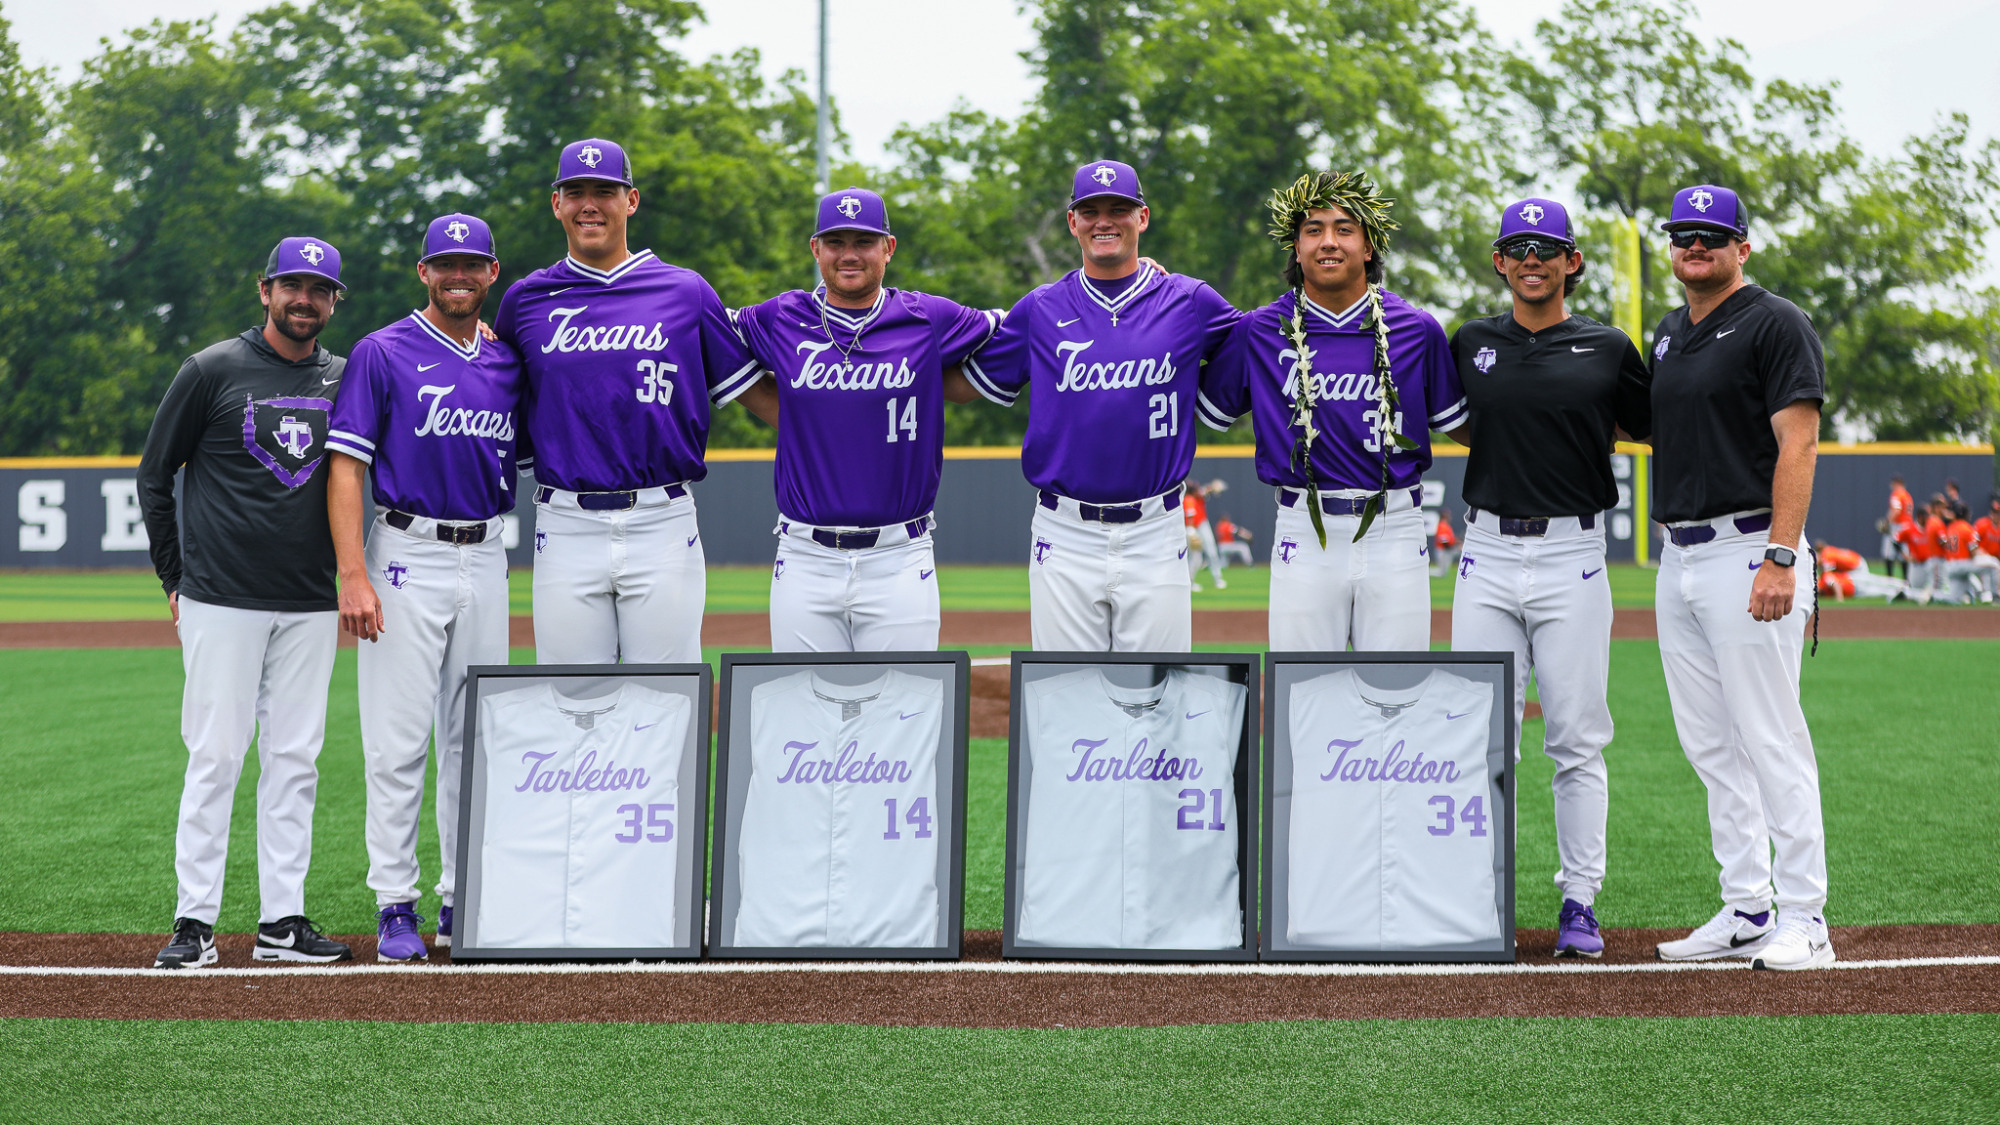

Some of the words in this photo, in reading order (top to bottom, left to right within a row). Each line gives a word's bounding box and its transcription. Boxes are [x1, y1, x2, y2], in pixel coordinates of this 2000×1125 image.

[542, 306, 669, 354] Texans
[636, 359, 678, 406] 35
[791, 340, 915, 391] Texans
[1056, 339, 1177, 392] Texans
[1278, 349, 1398, 401] Txan
[414, 385, 515, 442] Texans
[886, 396, 918, 443] 14
[1149, 391, 1178, 440] 21
[515, 750, 651, 793] Tarleton
[776, 739, 912, 784] Tarleton
[1066, 737, 1204, 783] Tarleton
[1319, 738, 1461, 784] Tarleton
[615, 803, 675, 844] 35
[883, 796, 932, 841] 14
[1176, 788, 1226, 832] 21
[1427, 794, 1488, 838] 34
